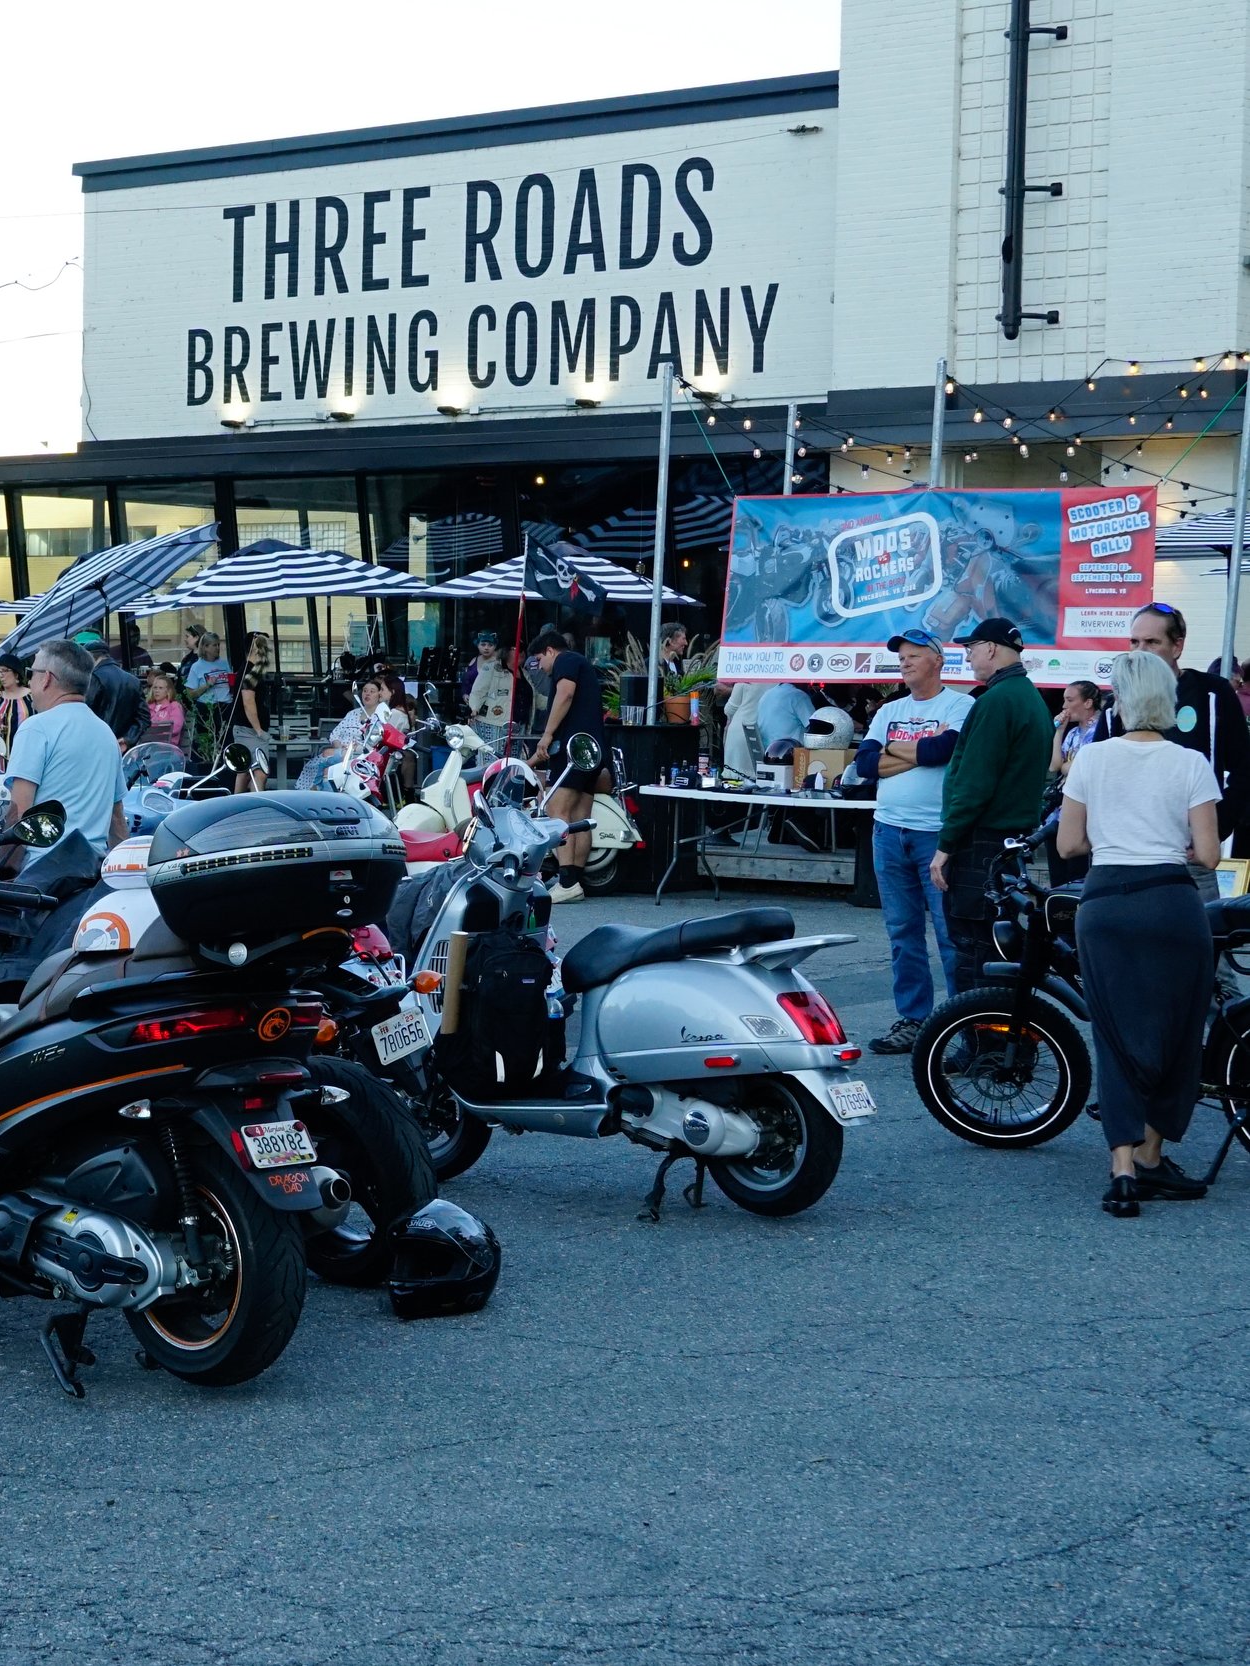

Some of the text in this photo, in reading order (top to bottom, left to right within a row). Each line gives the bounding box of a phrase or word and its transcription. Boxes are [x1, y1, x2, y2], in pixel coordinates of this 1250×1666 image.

[222, 156, 715, 303] THREE ROADS
[186, 283, 781, 407] BREWING COMPANY
[1069, 500, 1124, 521] SCOOTER
[1070, 514, 1149, 540] MOTORCYCLE
[854, 528, 911, 561] MODS
[1092, 537, 1130, 556] RALLY
[855, 557, 914, 582] ROCKERS
[1081, 620, 1126, 628] RIVERVIEWS
[727, 652, 784, 661] THANK YOU TO
[830, 658, 850, 666] DPO
[725, 664, 741, 673] OUR
[380, 1020, 424, 1057] 780656
[680, 1026, 728, 1043] Vespa
[253, 1133, 307, 1154] 388Y82
[268, 1172, 310, 1186] DRAGON
[283, 1182, 303, 1194] DAD
